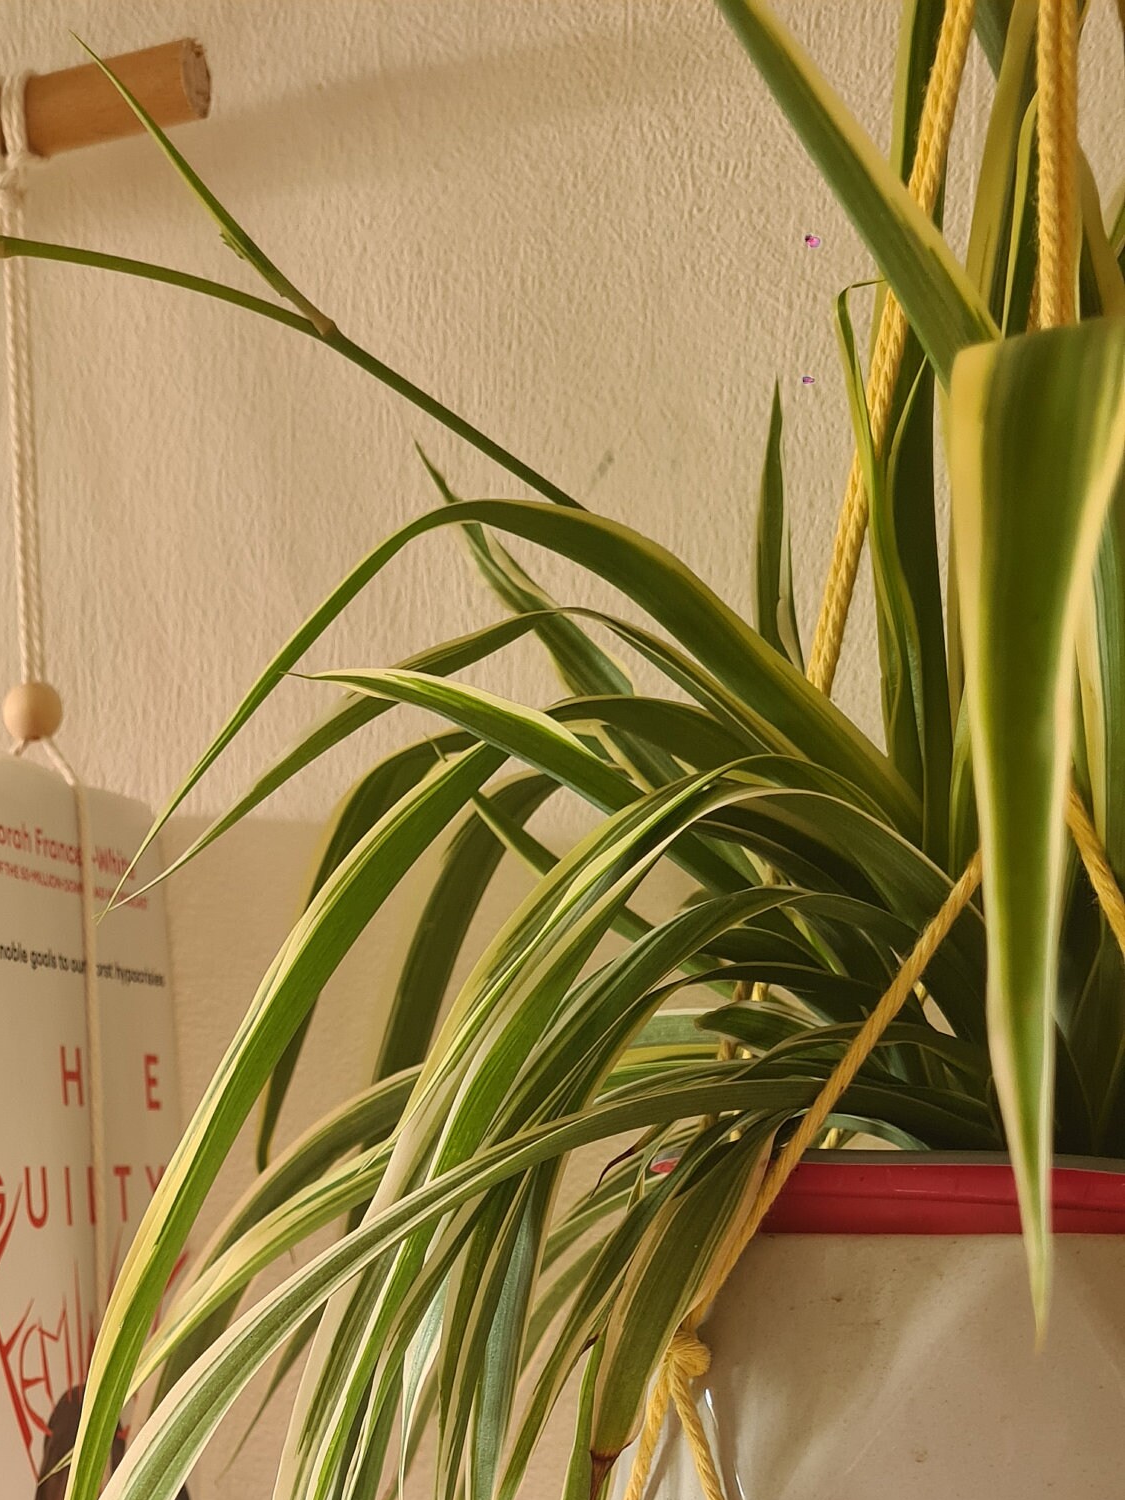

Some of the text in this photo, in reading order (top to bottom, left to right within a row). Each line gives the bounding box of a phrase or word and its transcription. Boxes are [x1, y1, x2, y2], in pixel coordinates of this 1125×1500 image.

[34, 827, 136, 881] France-White
[0, 941, 28, 963] noble
[30, 949, 57, 970] goals
[59, 955, 69, 971] to
